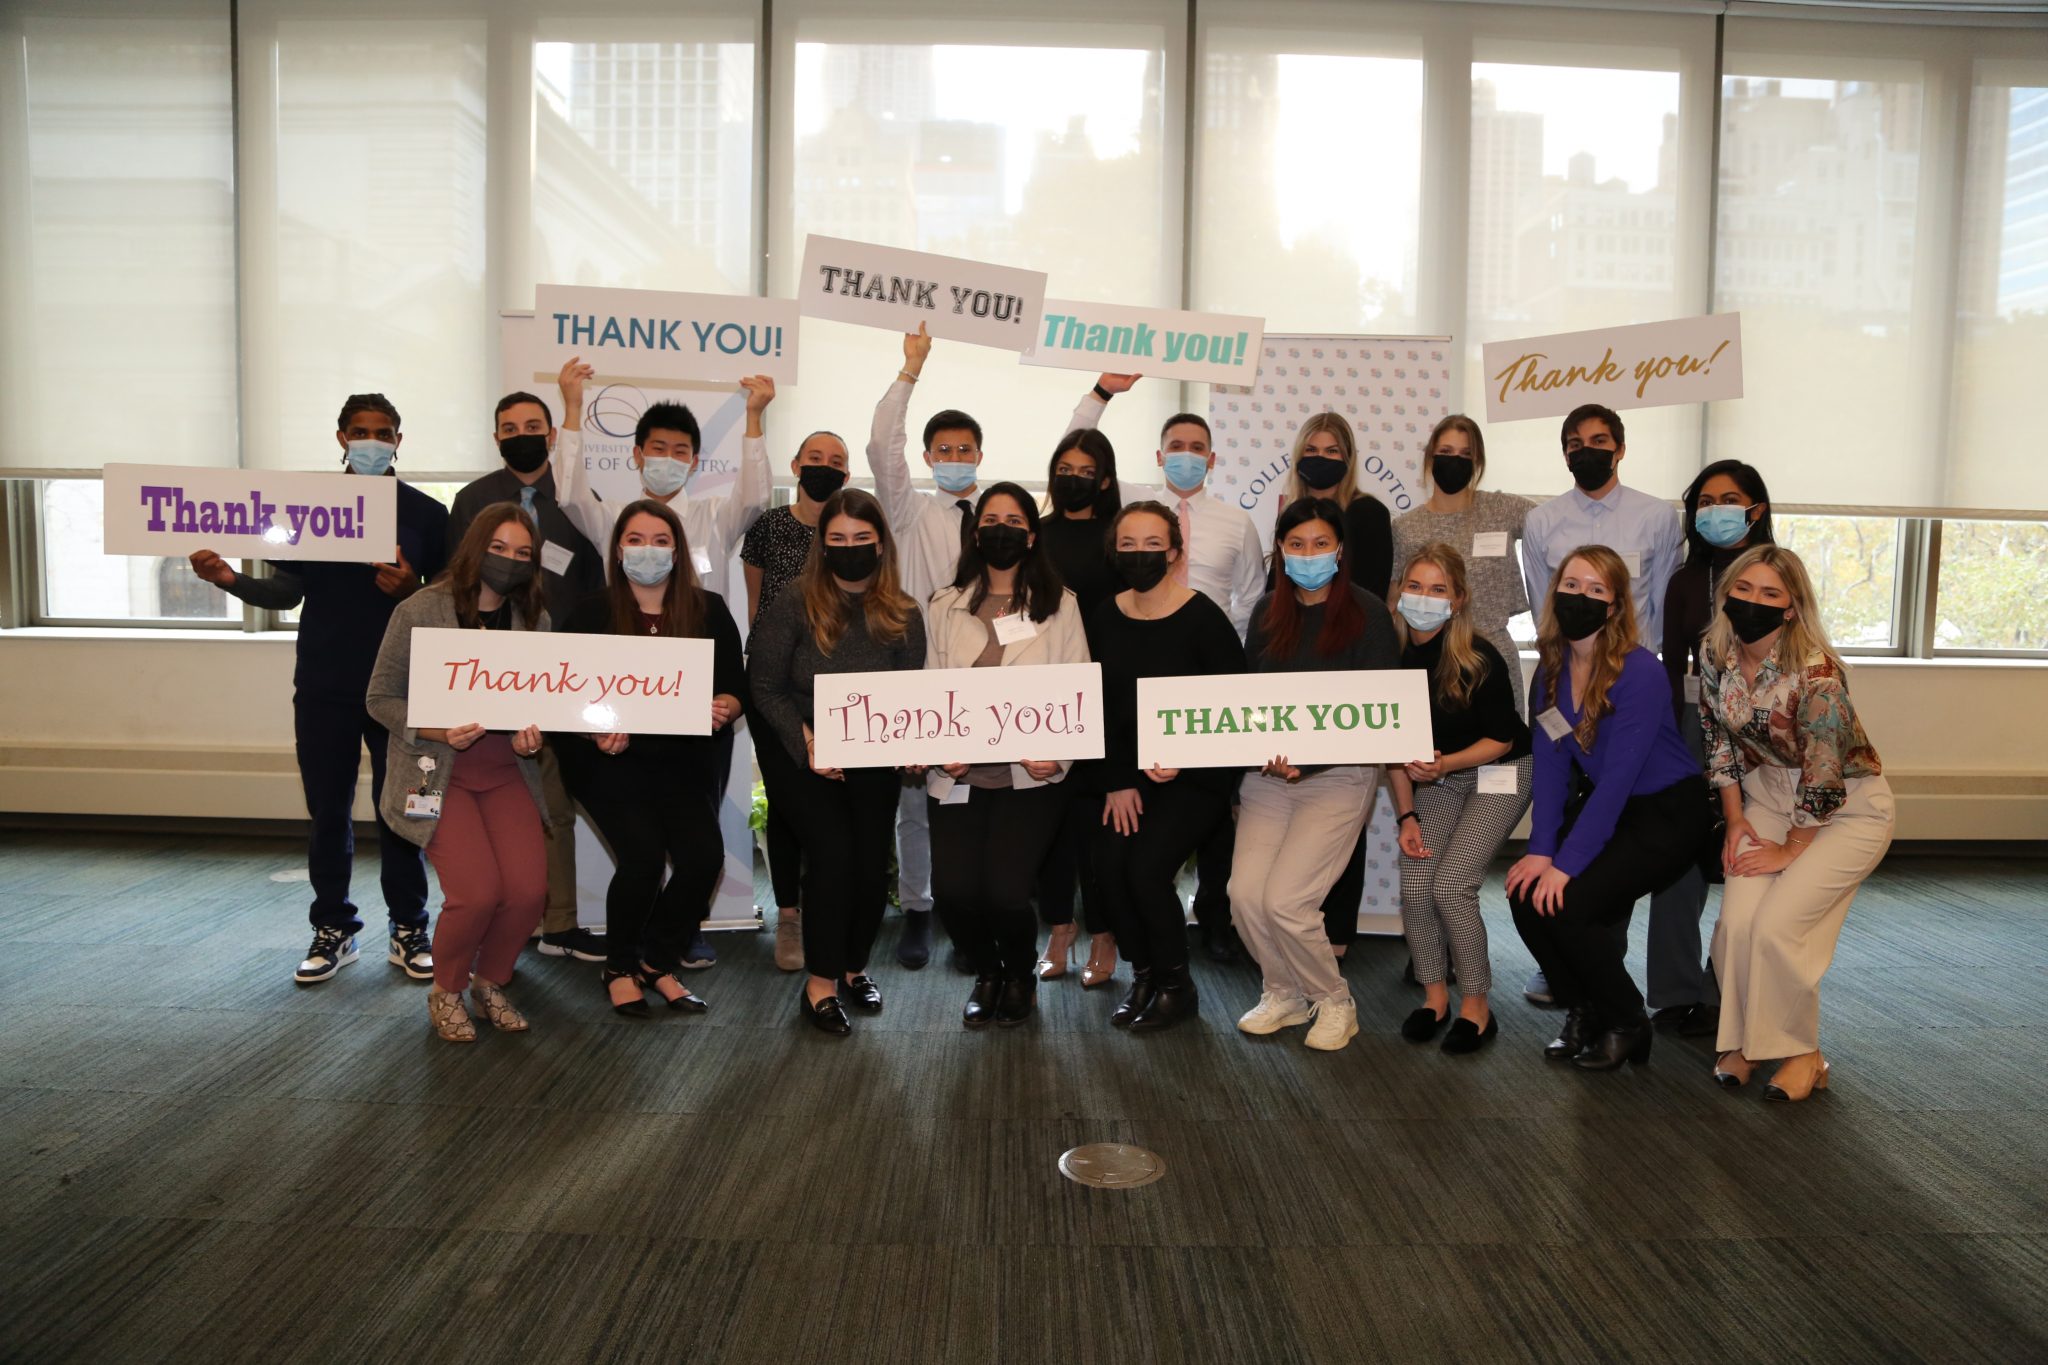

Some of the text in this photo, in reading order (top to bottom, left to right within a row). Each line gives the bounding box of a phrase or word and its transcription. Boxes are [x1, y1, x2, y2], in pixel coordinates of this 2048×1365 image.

[819, 264, 1024, 324] THANK YOU!
[552, 313, 783, 357] THANK YOU!
[1044, 314, 1248, 366] Thank you!
[1494, 347, 1627, 403] Thank
[1633, 340, 1731, 399] you!
[584, 443, 630, 454] IVERSITY
[598, 457, 621, 471] OF
[140, 485, 364, 546] Thank you!
[444, 658, 683, 704] Thank you!
[829, 690, 1085, 746] Thank you!
[1157, 702, 1401, 736] THANK YOU!
